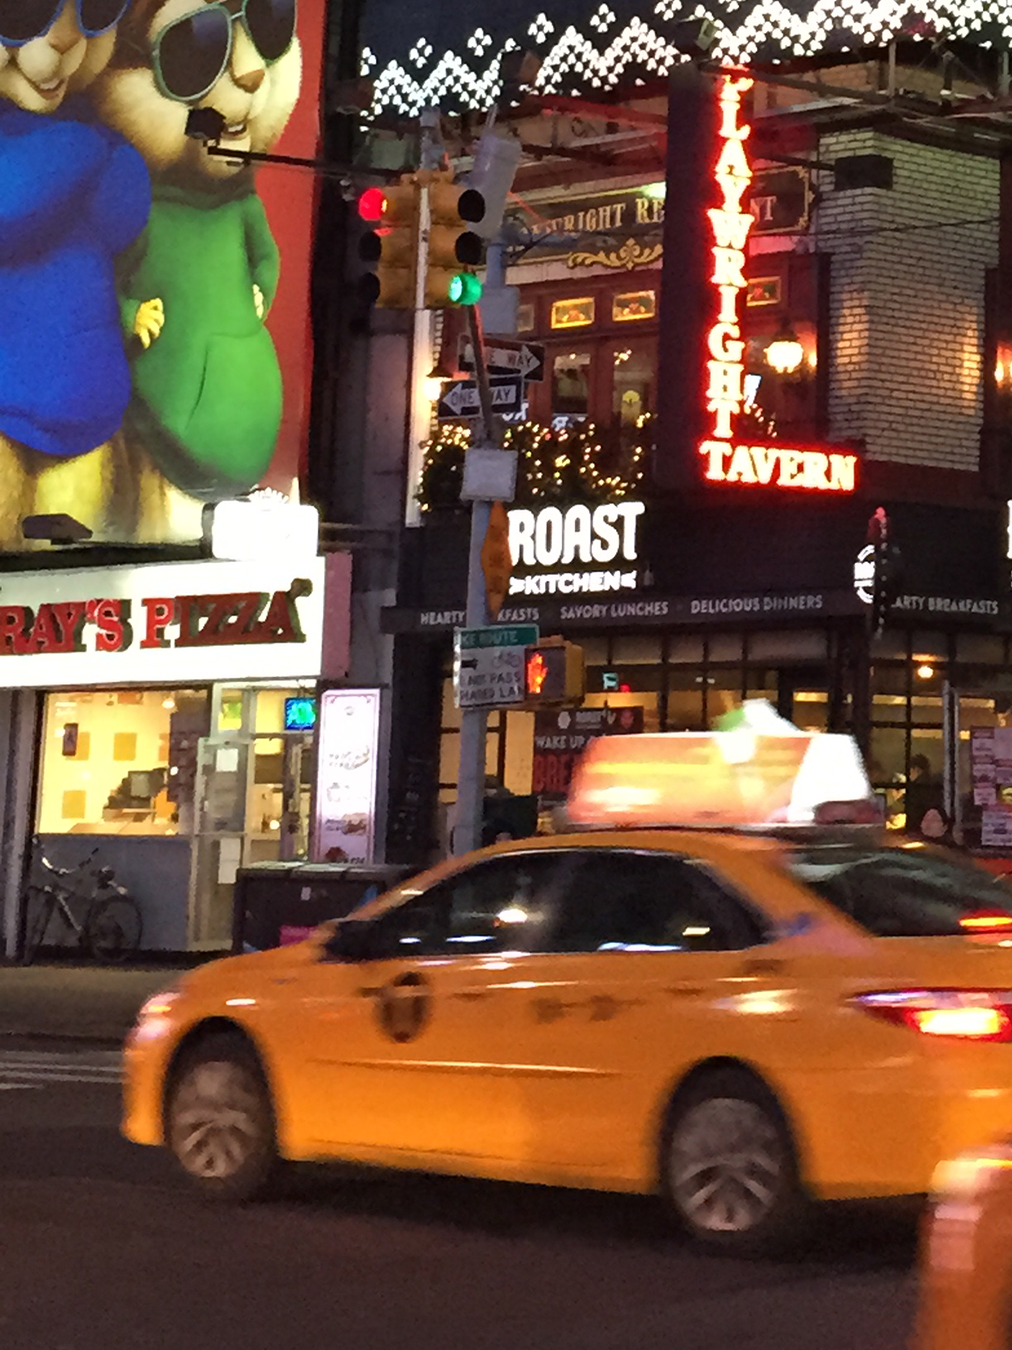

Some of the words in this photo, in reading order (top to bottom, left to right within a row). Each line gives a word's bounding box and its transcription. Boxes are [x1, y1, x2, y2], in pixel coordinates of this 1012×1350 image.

[450, 390, 475, 407] ONE
[699, 439, 858, 492] TAVERN
[507, 500, 646, 567] ROAST
[523, 571, 621, 596] KITCHEN
[560, 603, 609, 620] SAVORY
[611, 600, 669, 618] LUNCHES
[691, 597, 761, 615] DELICIOUS
[763, 594, 823, 612] DINNERS
[928, 596, 999, 616] BREAKFASTS
[0, 598, 132, 656] RAY'S
[140, 591, 307, 649] PIZZA
[535, 735, 567, 750] WAKE
